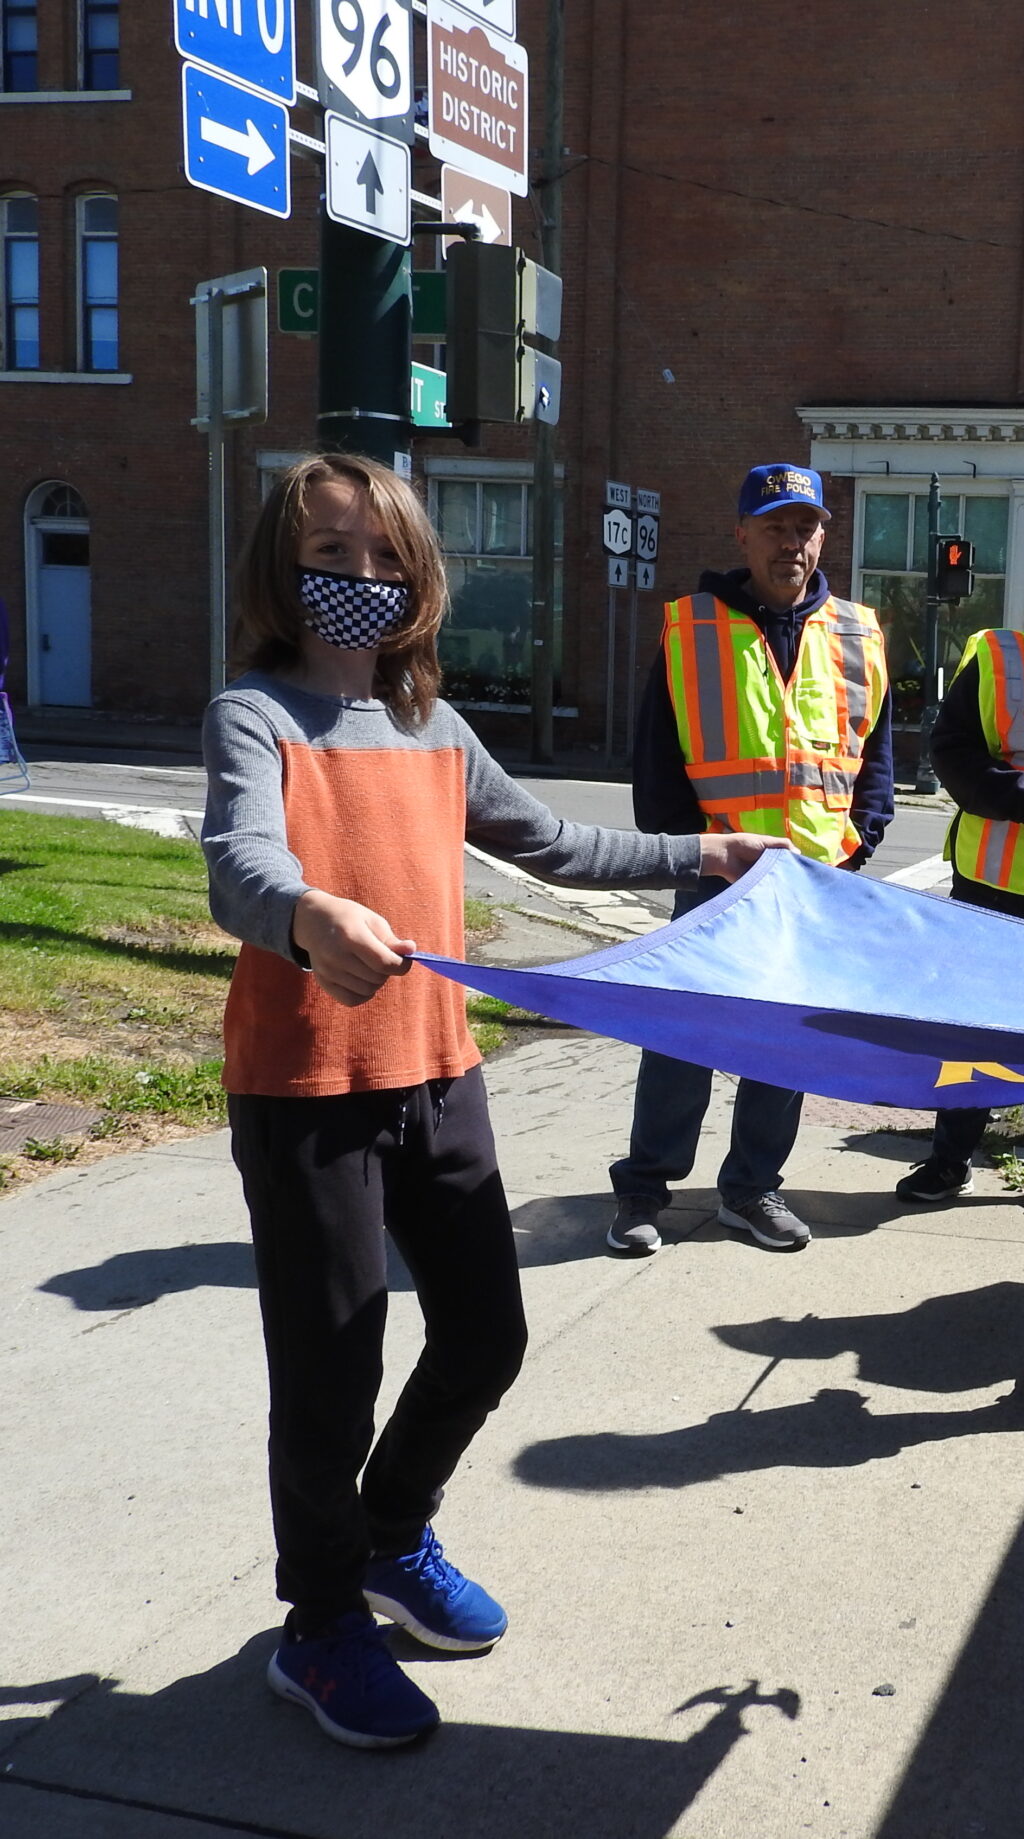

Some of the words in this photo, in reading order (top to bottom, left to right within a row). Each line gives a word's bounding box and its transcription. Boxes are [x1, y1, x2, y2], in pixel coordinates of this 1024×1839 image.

[331, 0, 401, 99] 96
[440, 40, 518, 109] HISTORIC
[442, 90, 517, 153] DISTRICT
[766, 471, 811, 486] OWEGO
[609, 487, 628, 503] WEST
[638, 493, 658, 510] NORTH
[761, 484, 781, 497] FIRE
[786, 483, 816, 500] POLICE
[608, 520, 628, 545] 17C
[639, 525, 656, 552] 96
